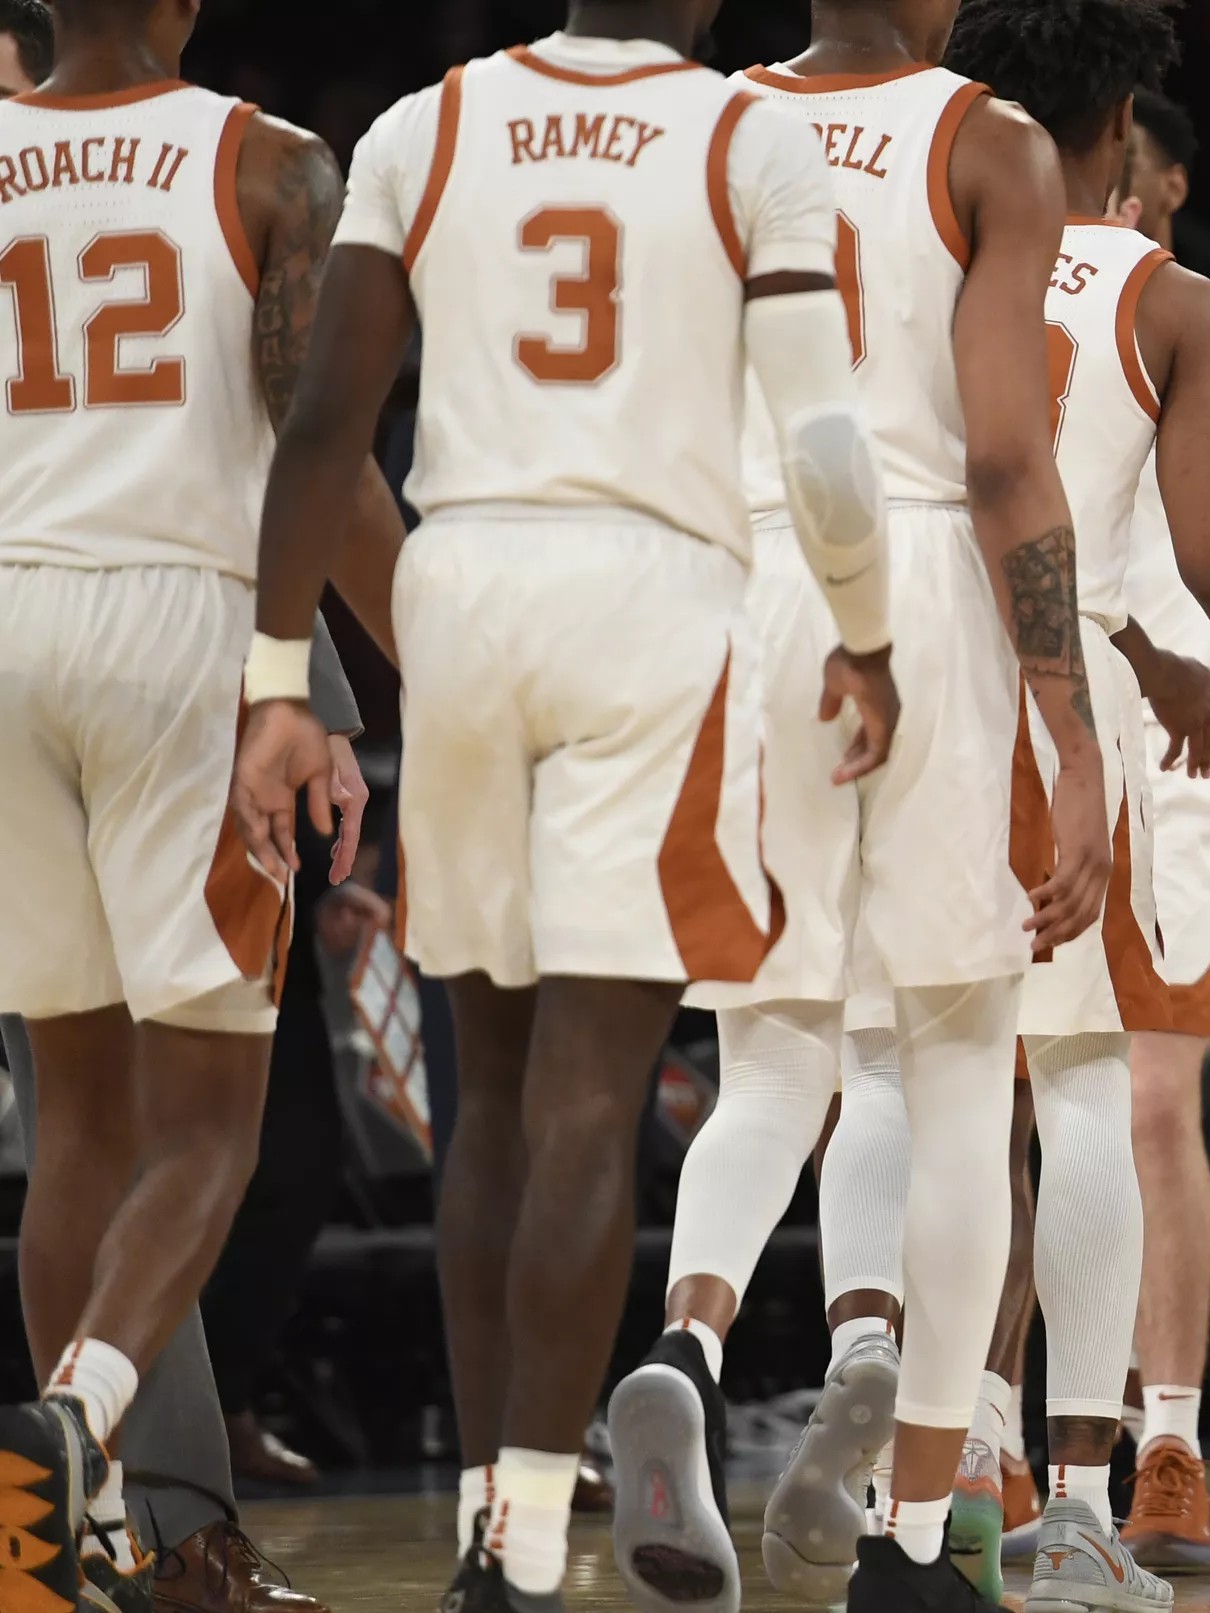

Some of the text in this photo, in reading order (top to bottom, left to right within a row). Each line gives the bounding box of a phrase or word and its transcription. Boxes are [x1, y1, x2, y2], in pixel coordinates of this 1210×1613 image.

[0, 136, 189, 204] ROACH II
[506, 112, 666, 168] RAMEY
[809, 122, 893, 179] ELL
[0, 228, 187, 416] 12
[512, 202, 626, 388] 3
